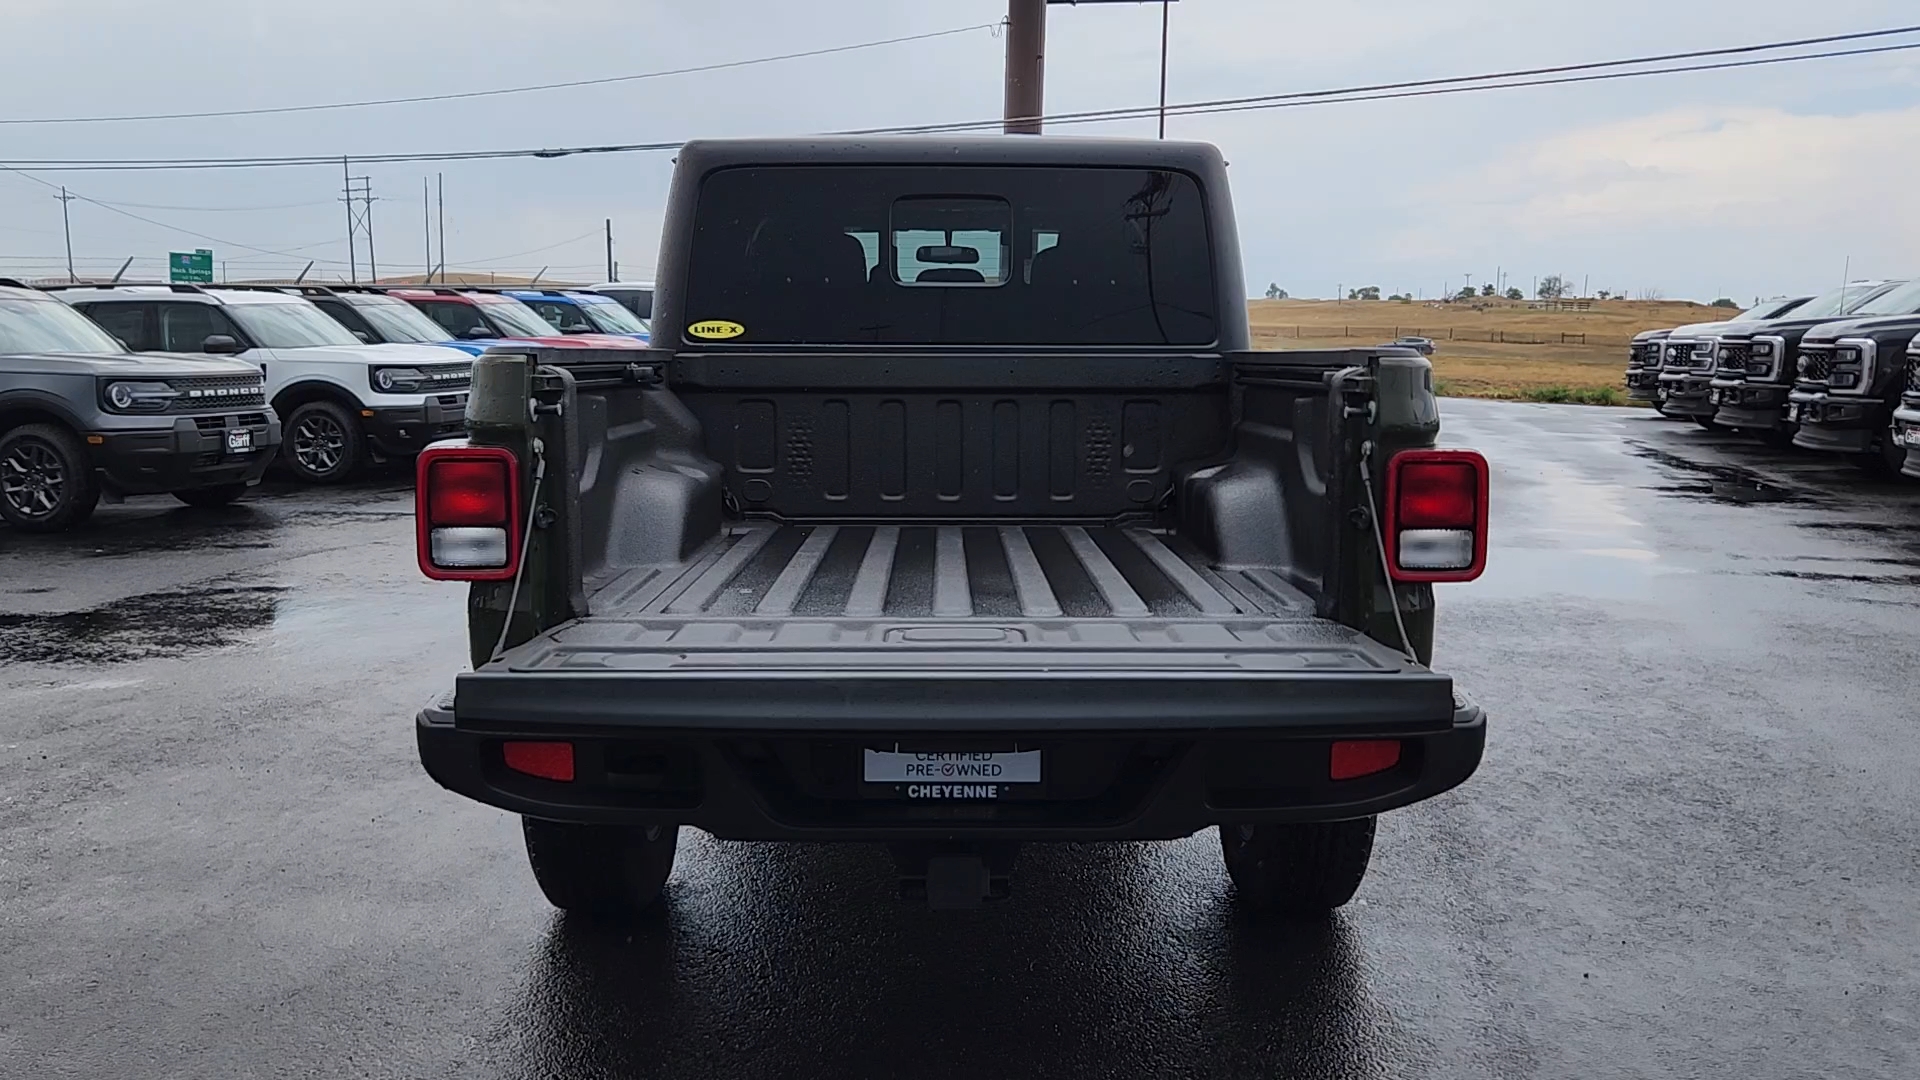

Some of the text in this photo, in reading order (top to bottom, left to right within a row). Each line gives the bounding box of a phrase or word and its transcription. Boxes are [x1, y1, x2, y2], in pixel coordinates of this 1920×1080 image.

[432, 372, 471, 380] BRONC
[189, 387, 259, 397] BRONCO
[915, 752, 993, 761] CERTIFIED
[908, 785, 997, 798] CHEYENNE
